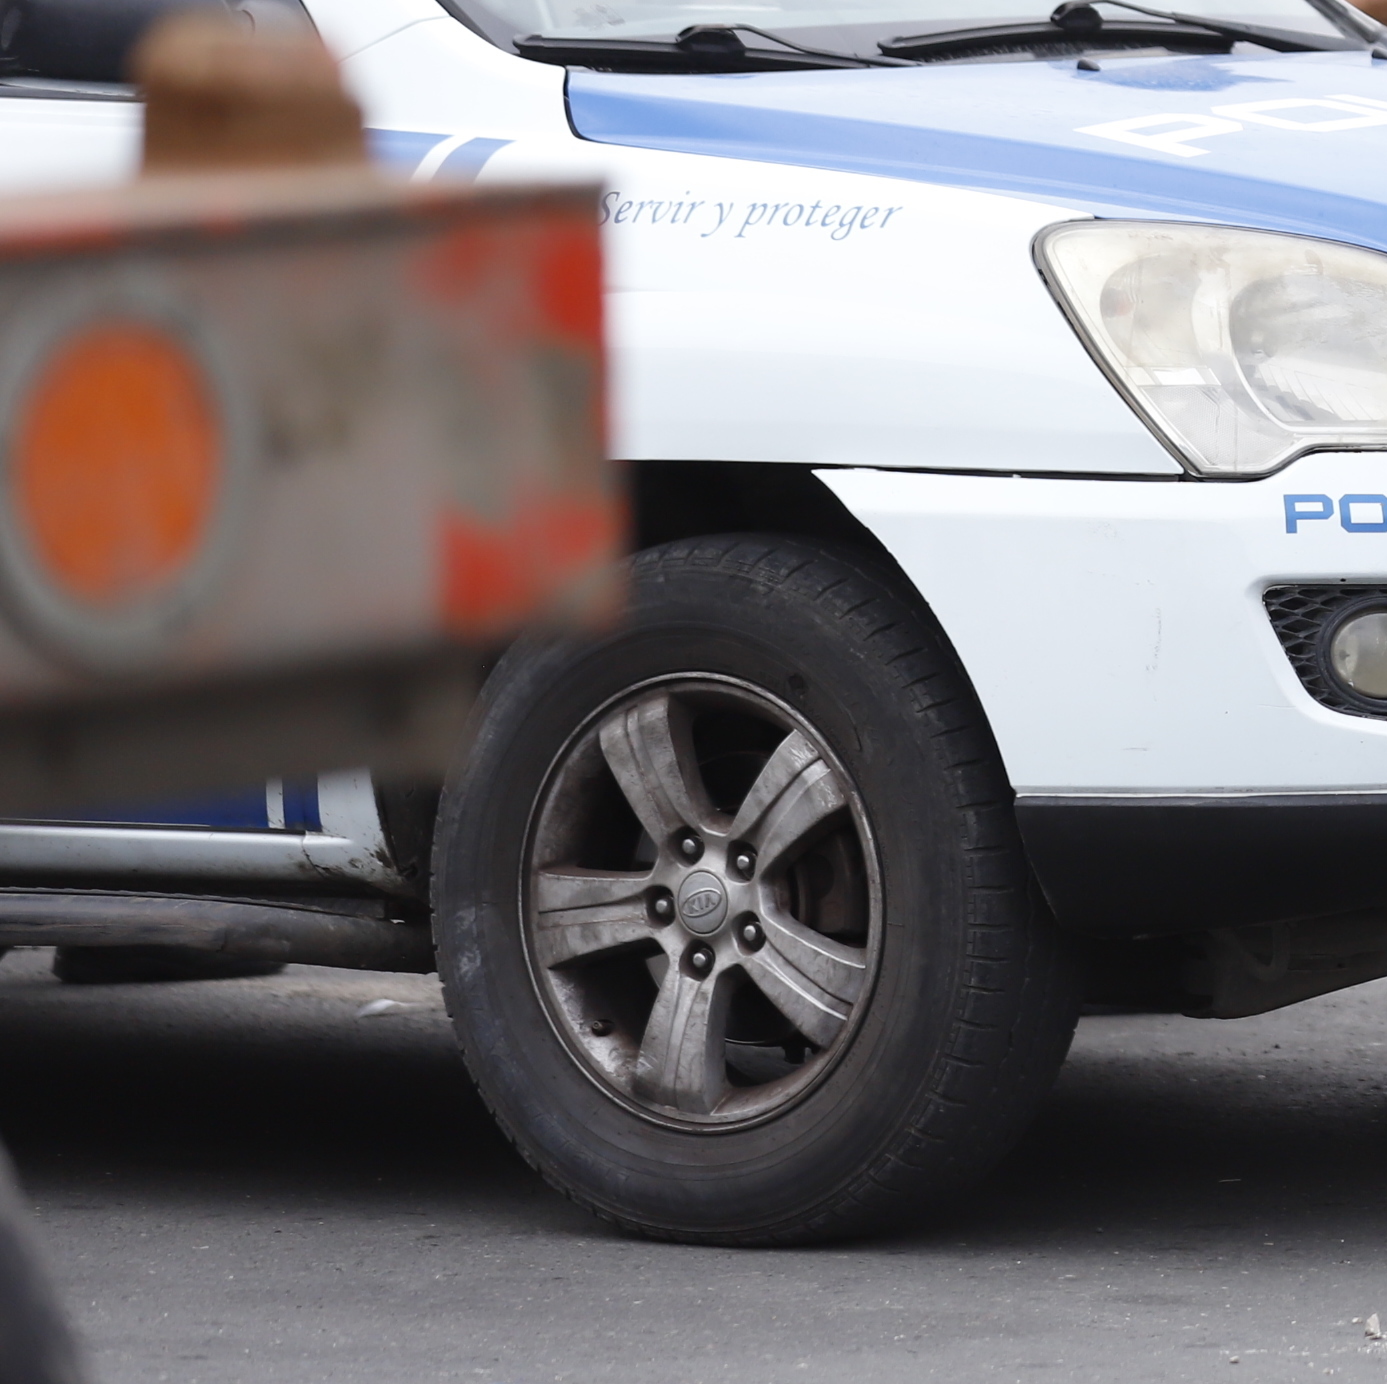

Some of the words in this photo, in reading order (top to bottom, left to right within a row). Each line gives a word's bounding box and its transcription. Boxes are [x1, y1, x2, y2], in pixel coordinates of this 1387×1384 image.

[600, 190, 704, 226] Servir
[701, 201, 734, 238] y
[734, 200, 903, 241] proteger
[683, 893, 717, 914] KIA
